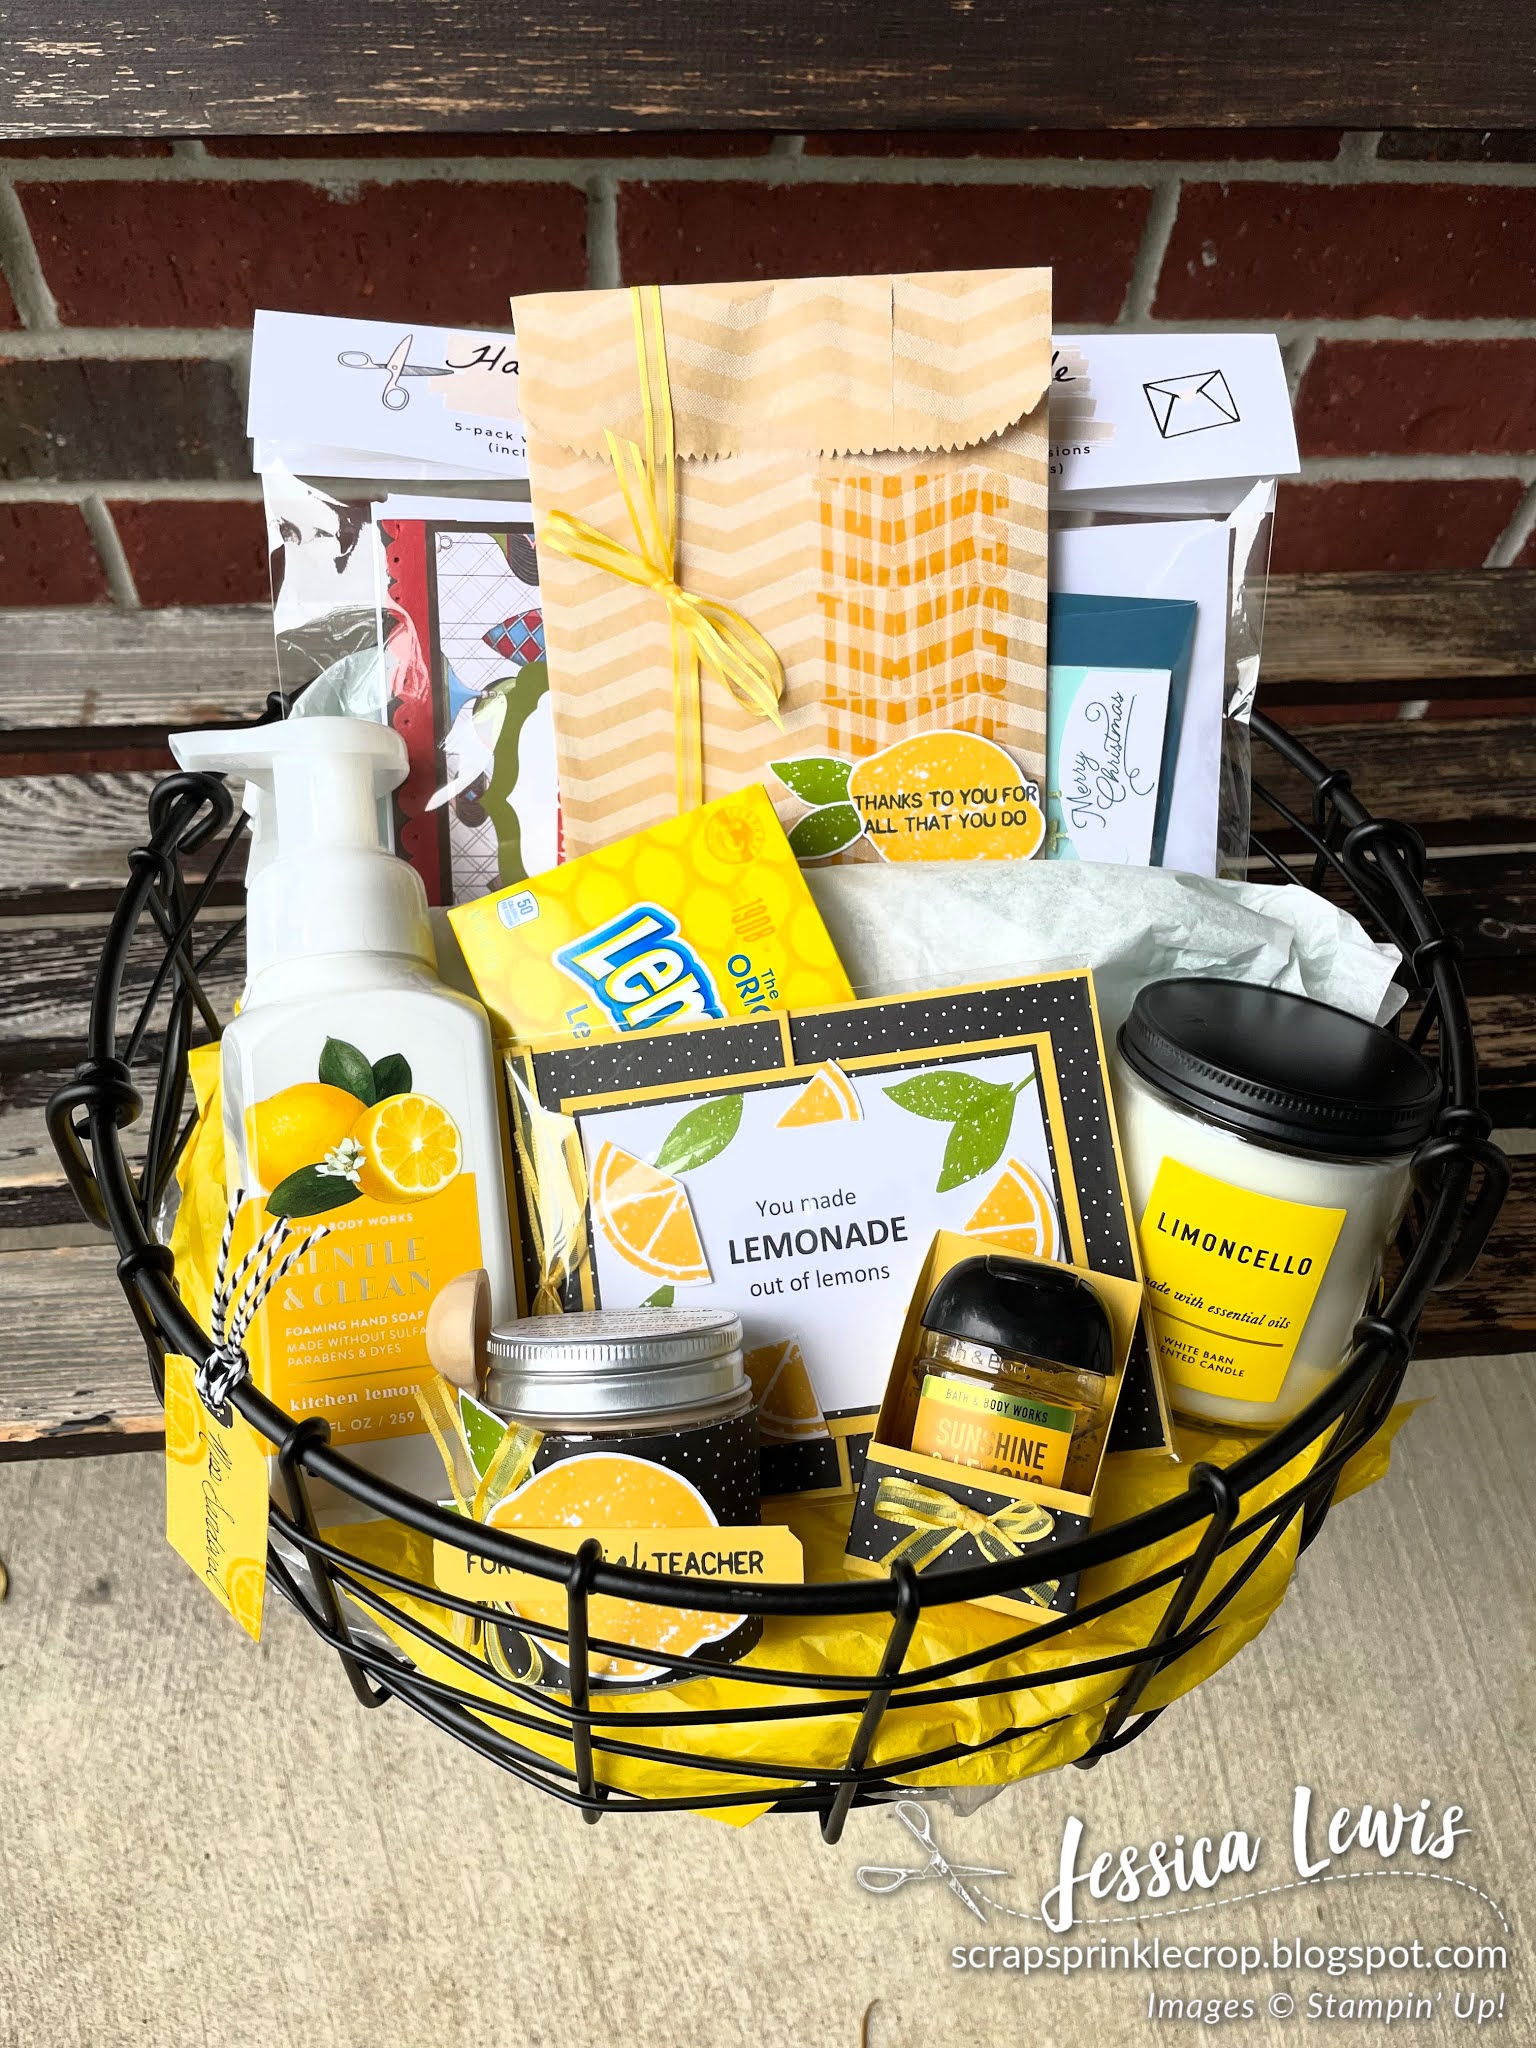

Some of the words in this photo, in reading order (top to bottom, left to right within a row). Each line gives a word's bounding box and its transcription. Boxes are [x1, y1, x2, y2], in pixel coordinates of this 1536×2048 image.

[454, 422, 514, 442] 5-pack
[1085, 691, 1126, 810] Christmas
[853, 792, 923, 811] THANKS
[929, 790, 954, 807] TO
[959, 788, 997, 805] YOU
[1002, 785, 1037, 802] FOR
[1066, 751, 1106, 828] Merry
[864, 818, 898, 834] ALL
[904, 814, 953, 832] THAT
[959, 812, 997, 828] YOU
[1002, 810, 1027, 826] DO
[761, 968, 779, 1000] The
[756, 1199, 794, 1217] You
[801, 1188, 857, 1212] made
[329, 1219, 364, 1232] BODY
[368, 1213, 414, 1225] WORKS
[728, 1215, 909, 1265] LEMONADE
[1157, 1211, 1313, 1276] LIMONCELLO
[282, 1287, 305, 1311] &
[313, 1268, 431, 1307] CLEAN
[750, 1278, 784, 1297] out
[790, 1271, 810, 1292] of
[816, 1265, 890, 1288] lemons
[285, 1320, 347, 1337] FOAMING
[351, 1315, 388, 1329] HAND
[391, 1310, 425, 1324] SOAP
[1174, 1291, 1205, 1309] with
[1207, 1304, 1266, 1326] essential
[1267, 1316, 1291, 1330] oils
[287, 1339, 324, 1353] MADE
[327, 1331, 386, 1347] WITHOUT
[287, 1350, 355, 1368] PARABENS
[359, 1348, 367, 1359] &
[370, 1343, 402, 1357] DYES
[1164, 1336, 1200, 1356] WHITE
[1203, 1351, 1235, 1365] BARN
[1158, 1345, 1196, 1364] ENTED
[1199, 1360, 1245, 1378] CANDLE
[290, 1393, 358, 1412] kitchen
[365, 1384, 421, 1401] lemon
[945, 1388, 969, 1403] BATH
[983, 1398, 1010, 1415] BODY
[1012, 1404, 1049, 1424] WORKS
[350, 1418, 373, 1431] OZ
[389, 1411, 415, 1425] 259
[936, 1418, 1049, 1470] SUNSHINE
[651, 1550, 765, 1575] TEACHER
